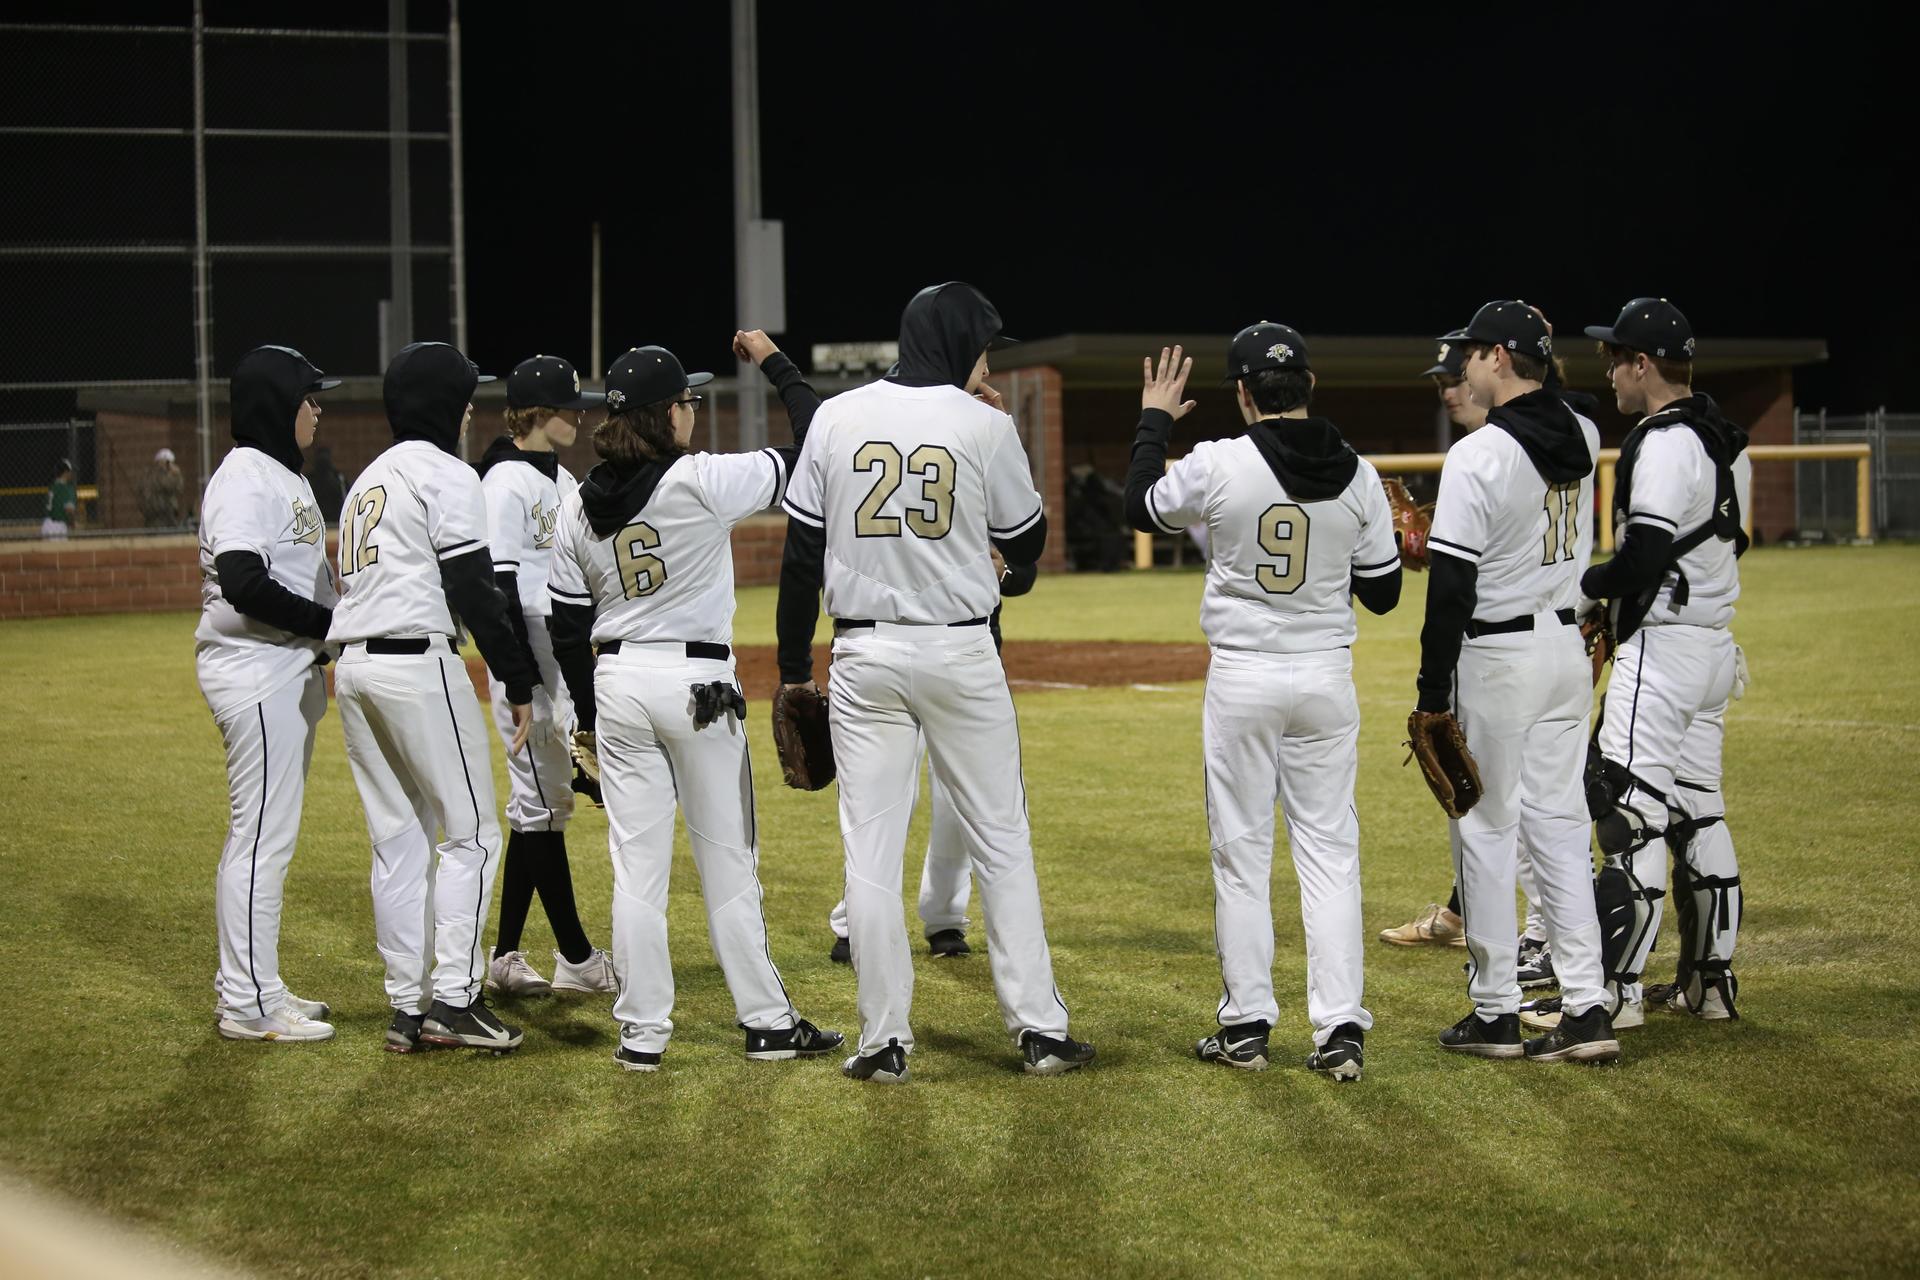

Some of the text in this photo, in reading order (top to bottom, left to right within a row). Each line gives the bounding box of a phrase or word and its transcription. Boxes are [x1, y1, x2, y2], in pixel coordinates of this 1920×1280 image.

[342, 484, 388, 577] 12
[853, 440, 957, 540] 23
[1541, 481, 1581, 566] 11
[612, 520, 668, 601] 6
[1255, 503, 1311, 595] 9
